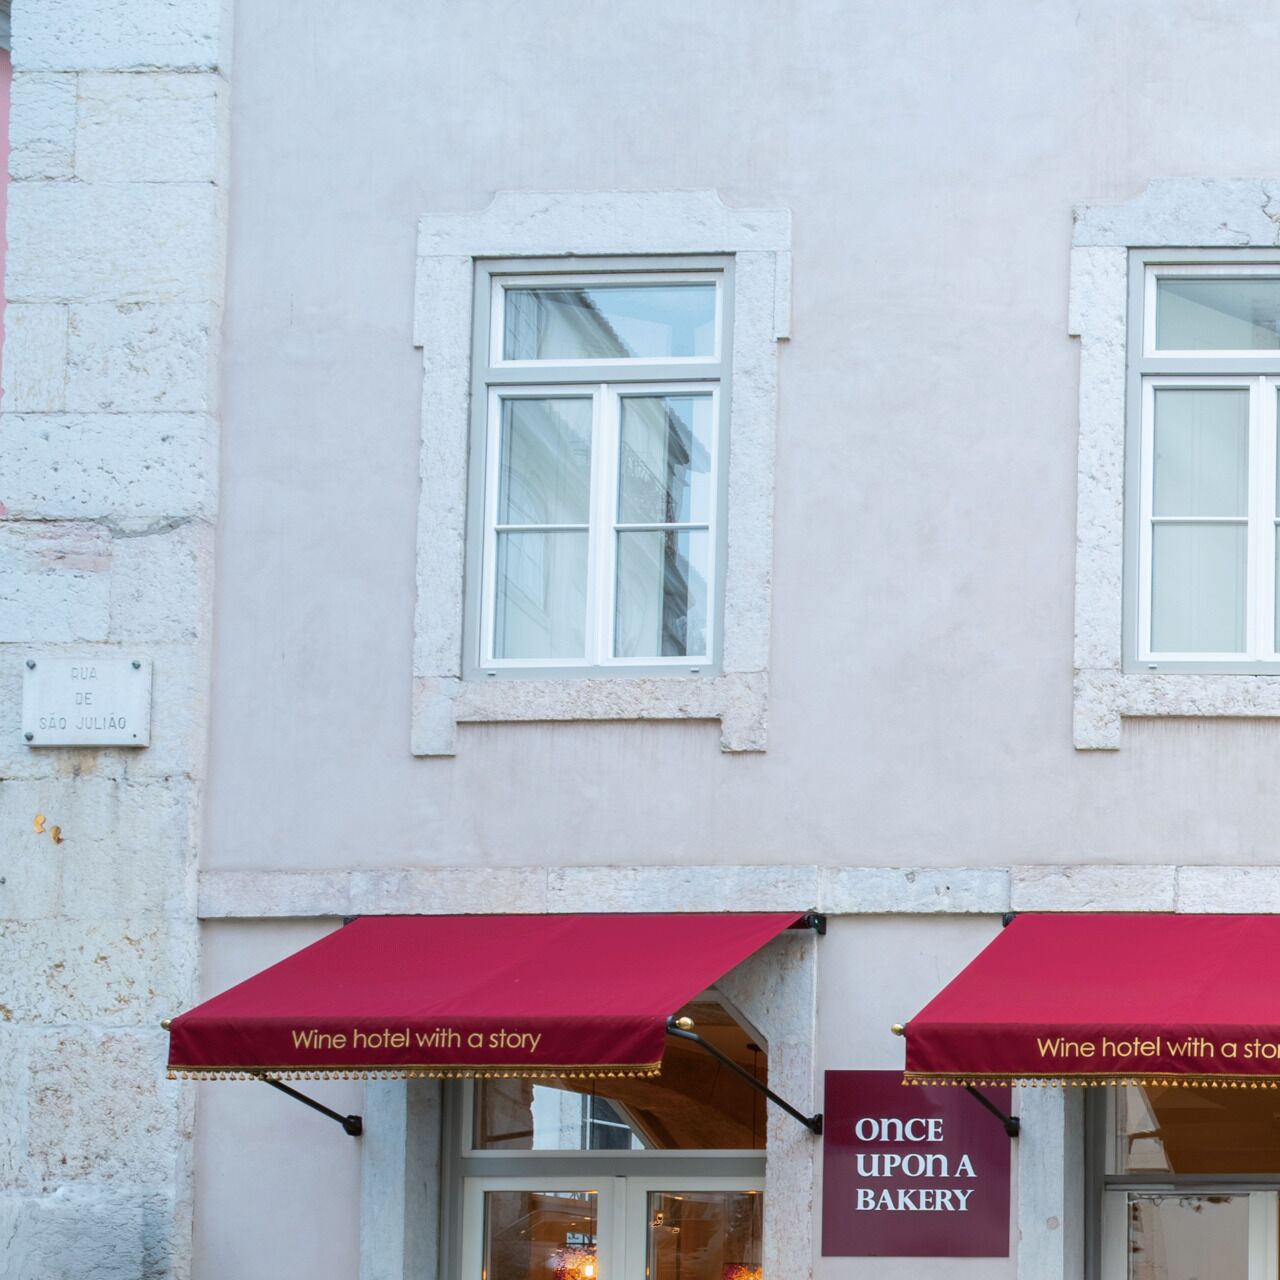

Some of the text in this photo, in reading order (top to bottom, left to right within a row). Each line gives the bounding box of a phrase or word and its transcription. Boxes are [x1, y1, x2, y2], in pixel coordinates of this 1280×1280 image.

[71, 667, 97, 681] RUA
[75, 692, 93, 706] DE
[40, 712, 126, 730] SÃO JULIÃO
[293, 1028, 541, 1053] Wine hotel with a story
[1037, 1038, 1095, 1058] Wine
[1102, 1037, 1161, 1057] hotel
[1167, 1037, 1215, 1058] with
[1221, 1042, 1237, 1058] a
[955, 1154, 977, 1178] A
[856, 1188, 974, 1212] BAKERY
